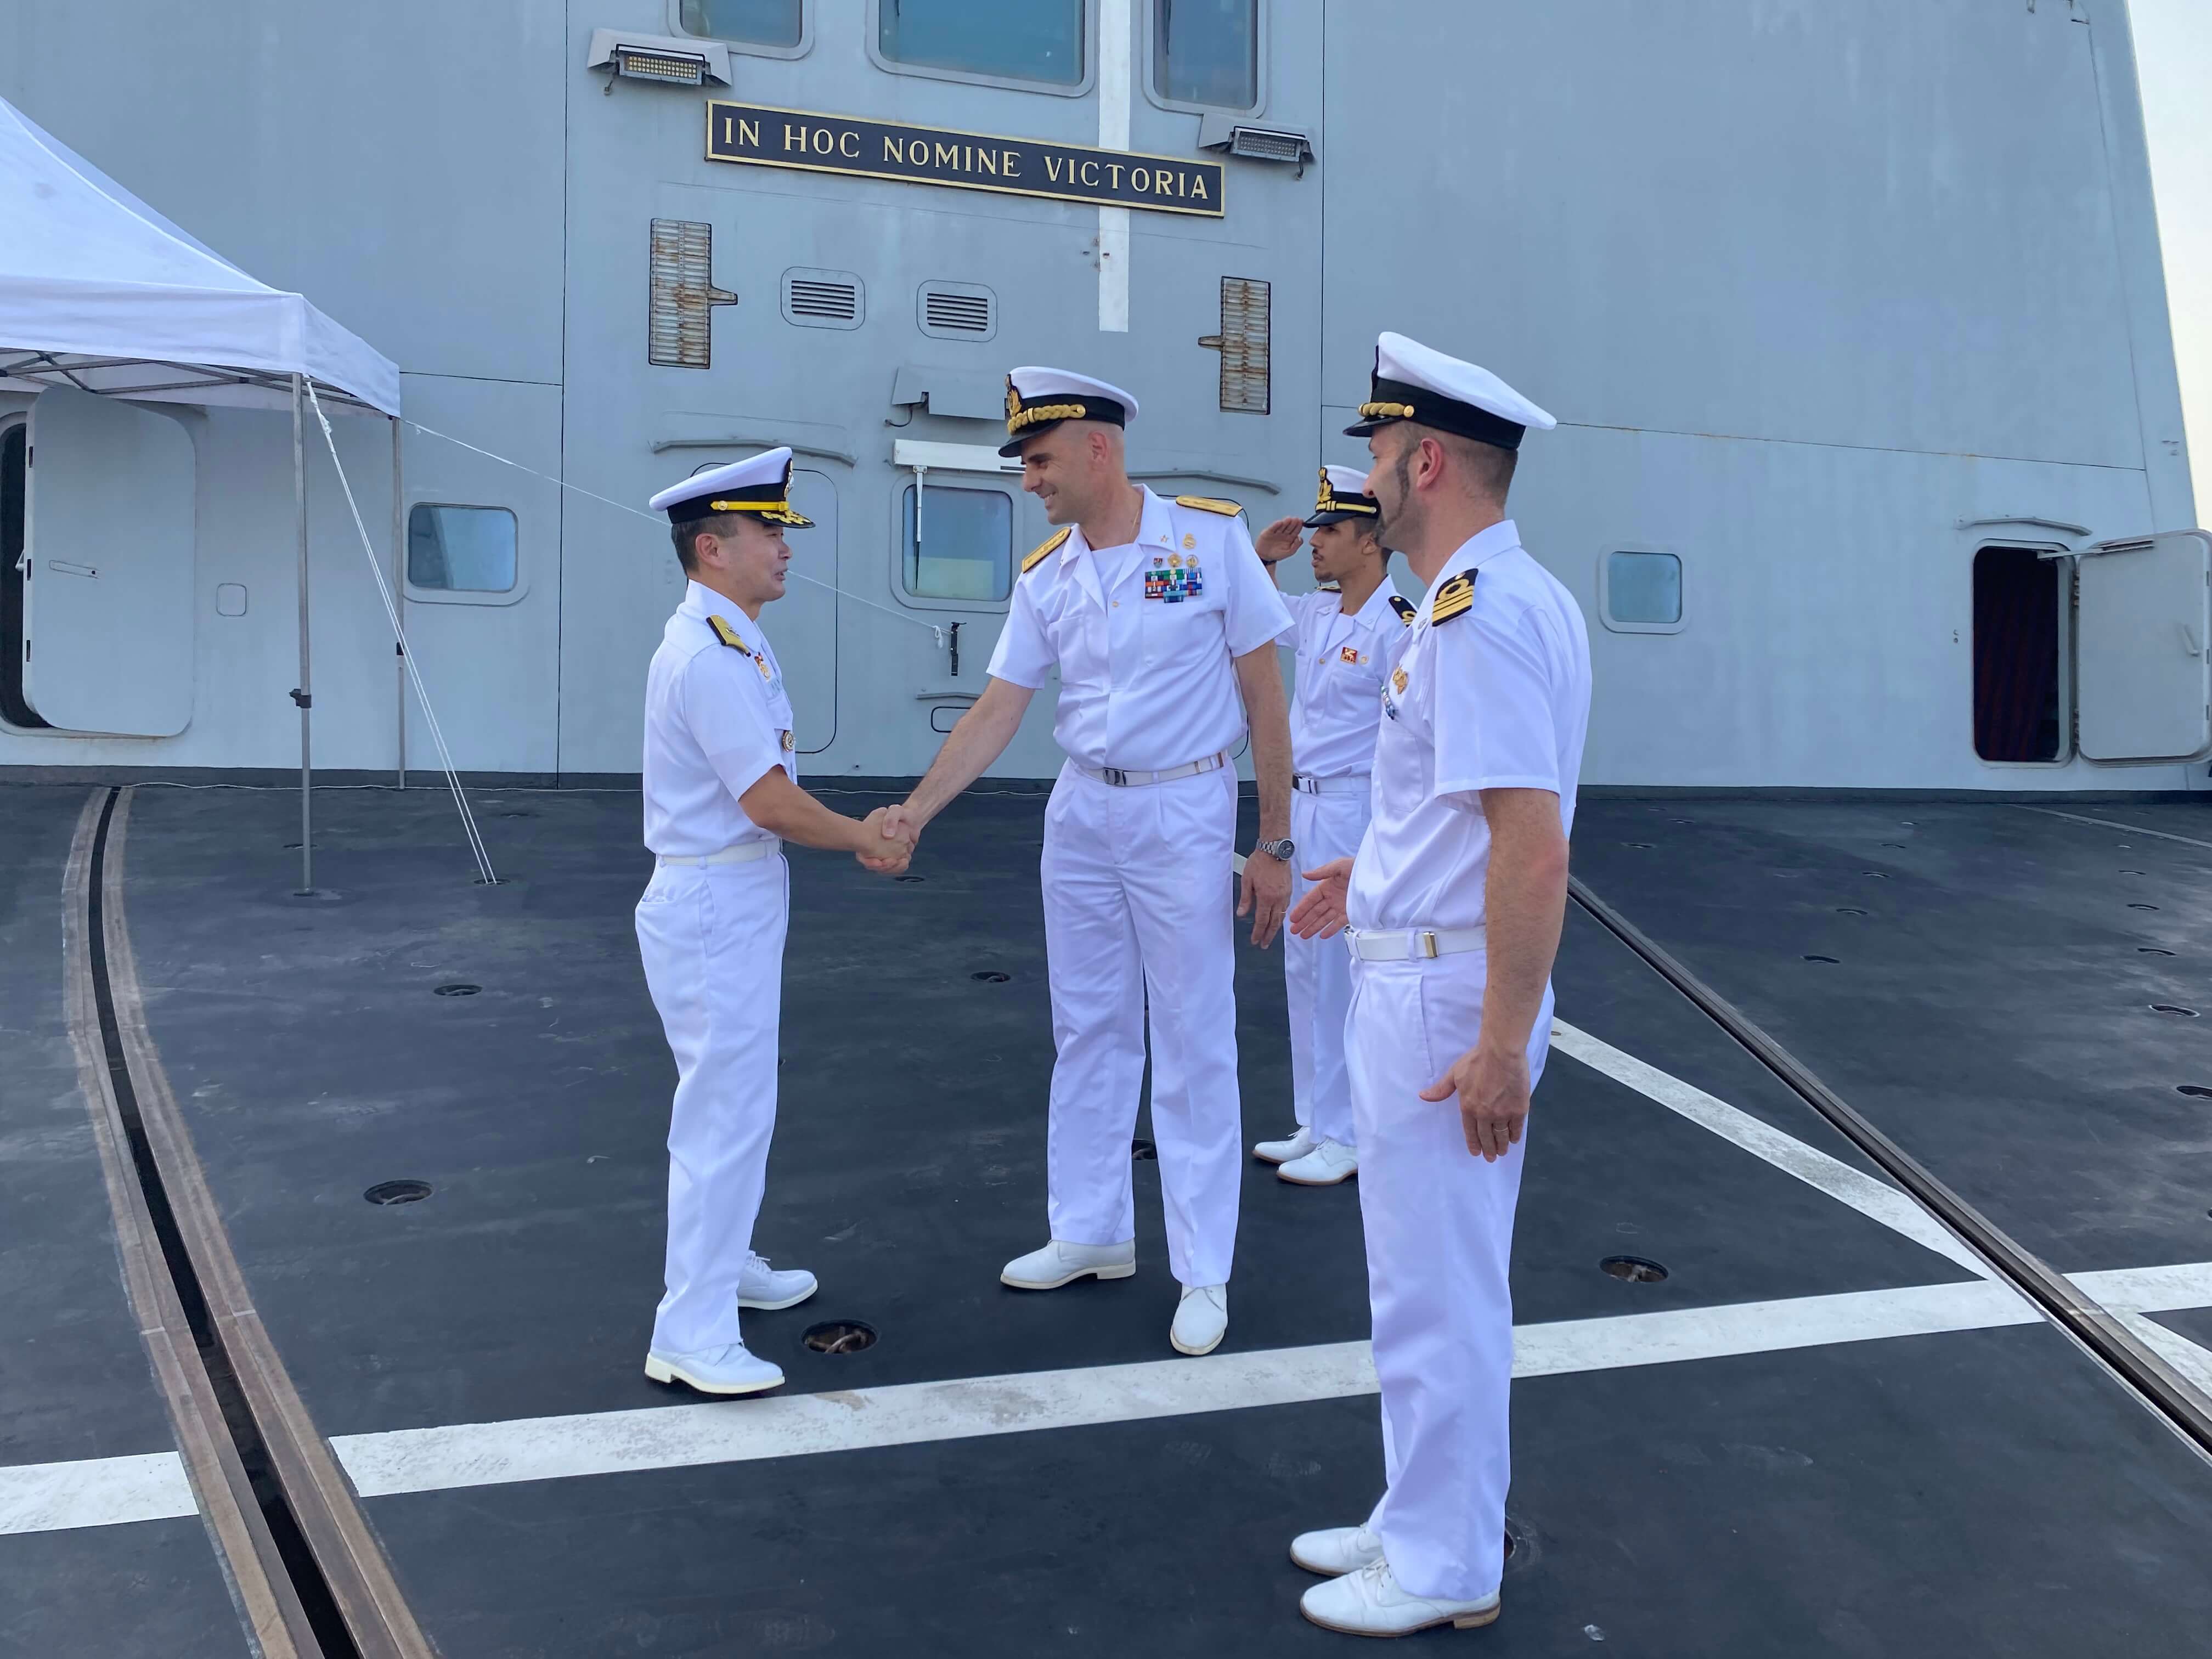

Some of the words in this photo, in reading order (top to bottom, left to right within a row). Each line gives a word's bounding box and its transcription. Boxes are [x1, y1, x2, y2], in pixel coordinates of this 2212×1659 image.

[724, 116, 760, 148] IN
[783, 123, 860, 159] HOC
[883, 136, 1022, 178] NOMINE
[1043, 156, 1209, 200] VICTORIA
